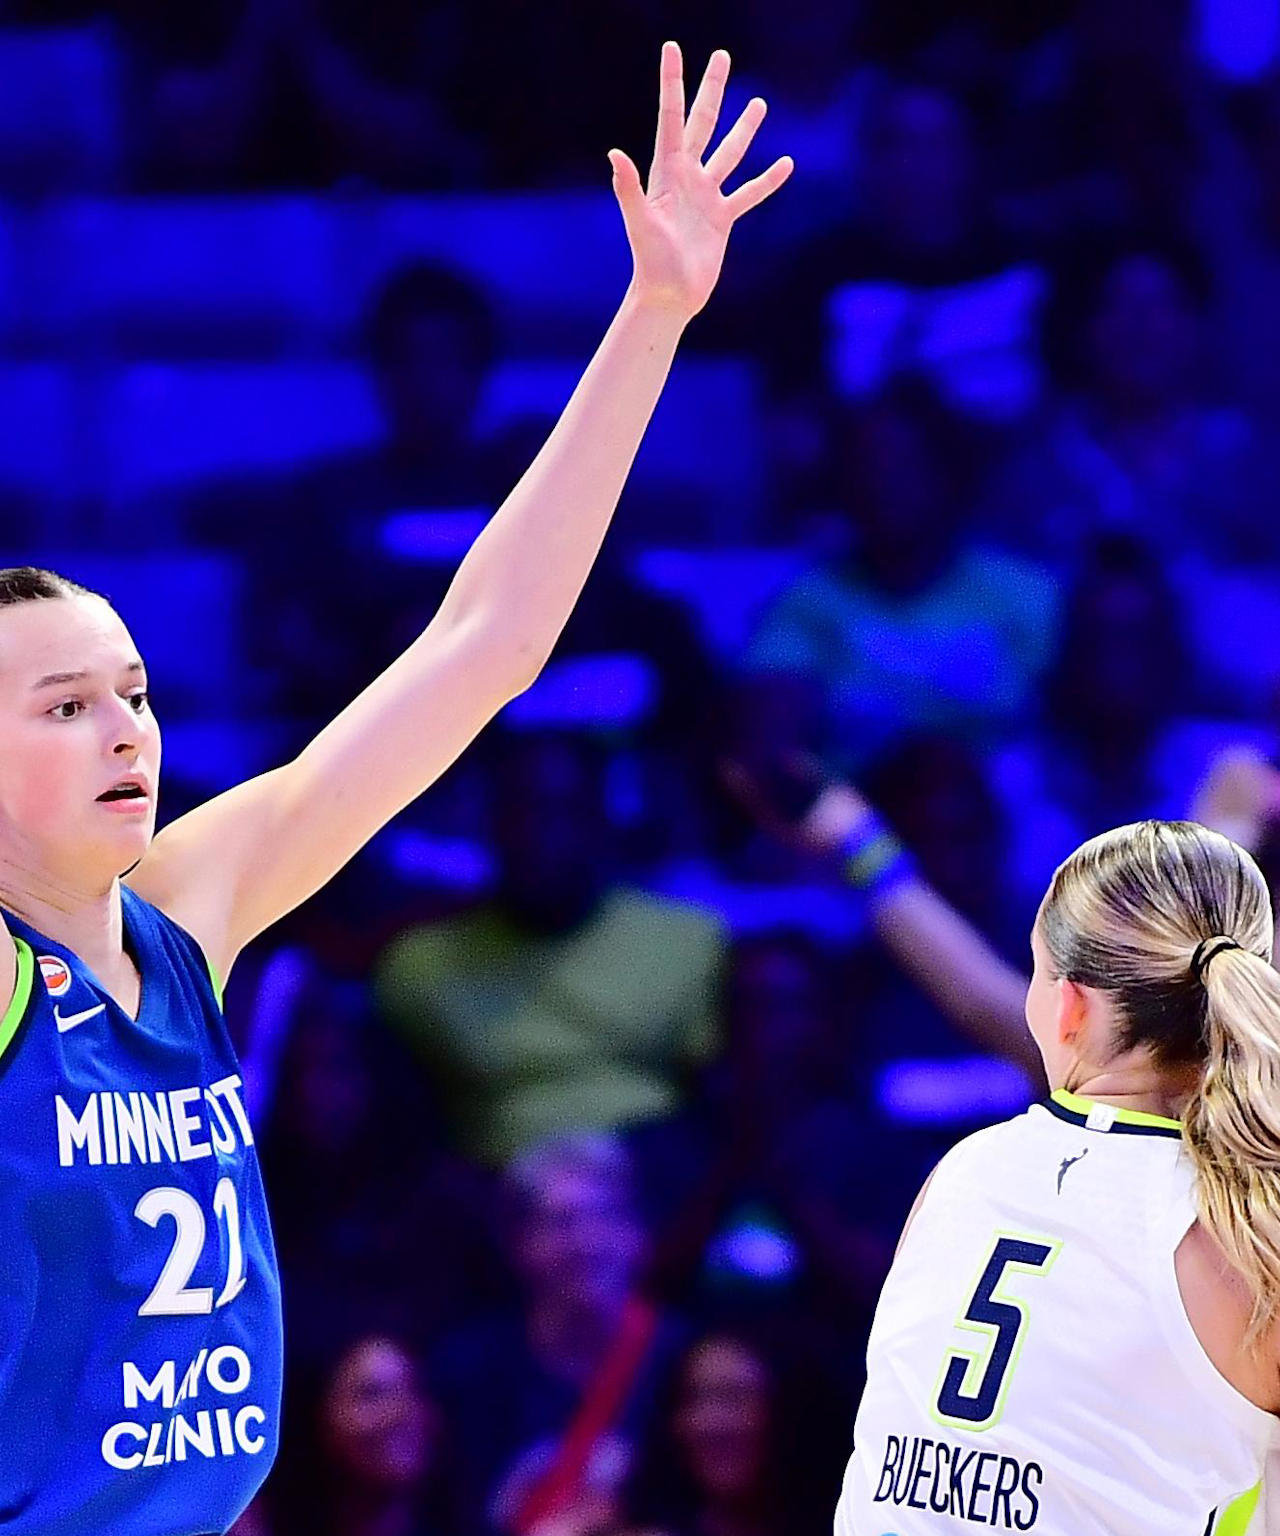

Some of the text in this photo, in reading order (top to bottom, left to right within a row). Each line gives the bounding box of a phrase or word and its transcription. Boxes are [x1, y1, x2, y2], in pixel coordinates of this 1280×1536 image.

[931, 1231, 1062, 1431] 5
[122, 1345, 251, 1409] MAYO
[101, 1404, 266, 1470] CLINIC
[873, 1435, 1043, 1531] BUECKERS
